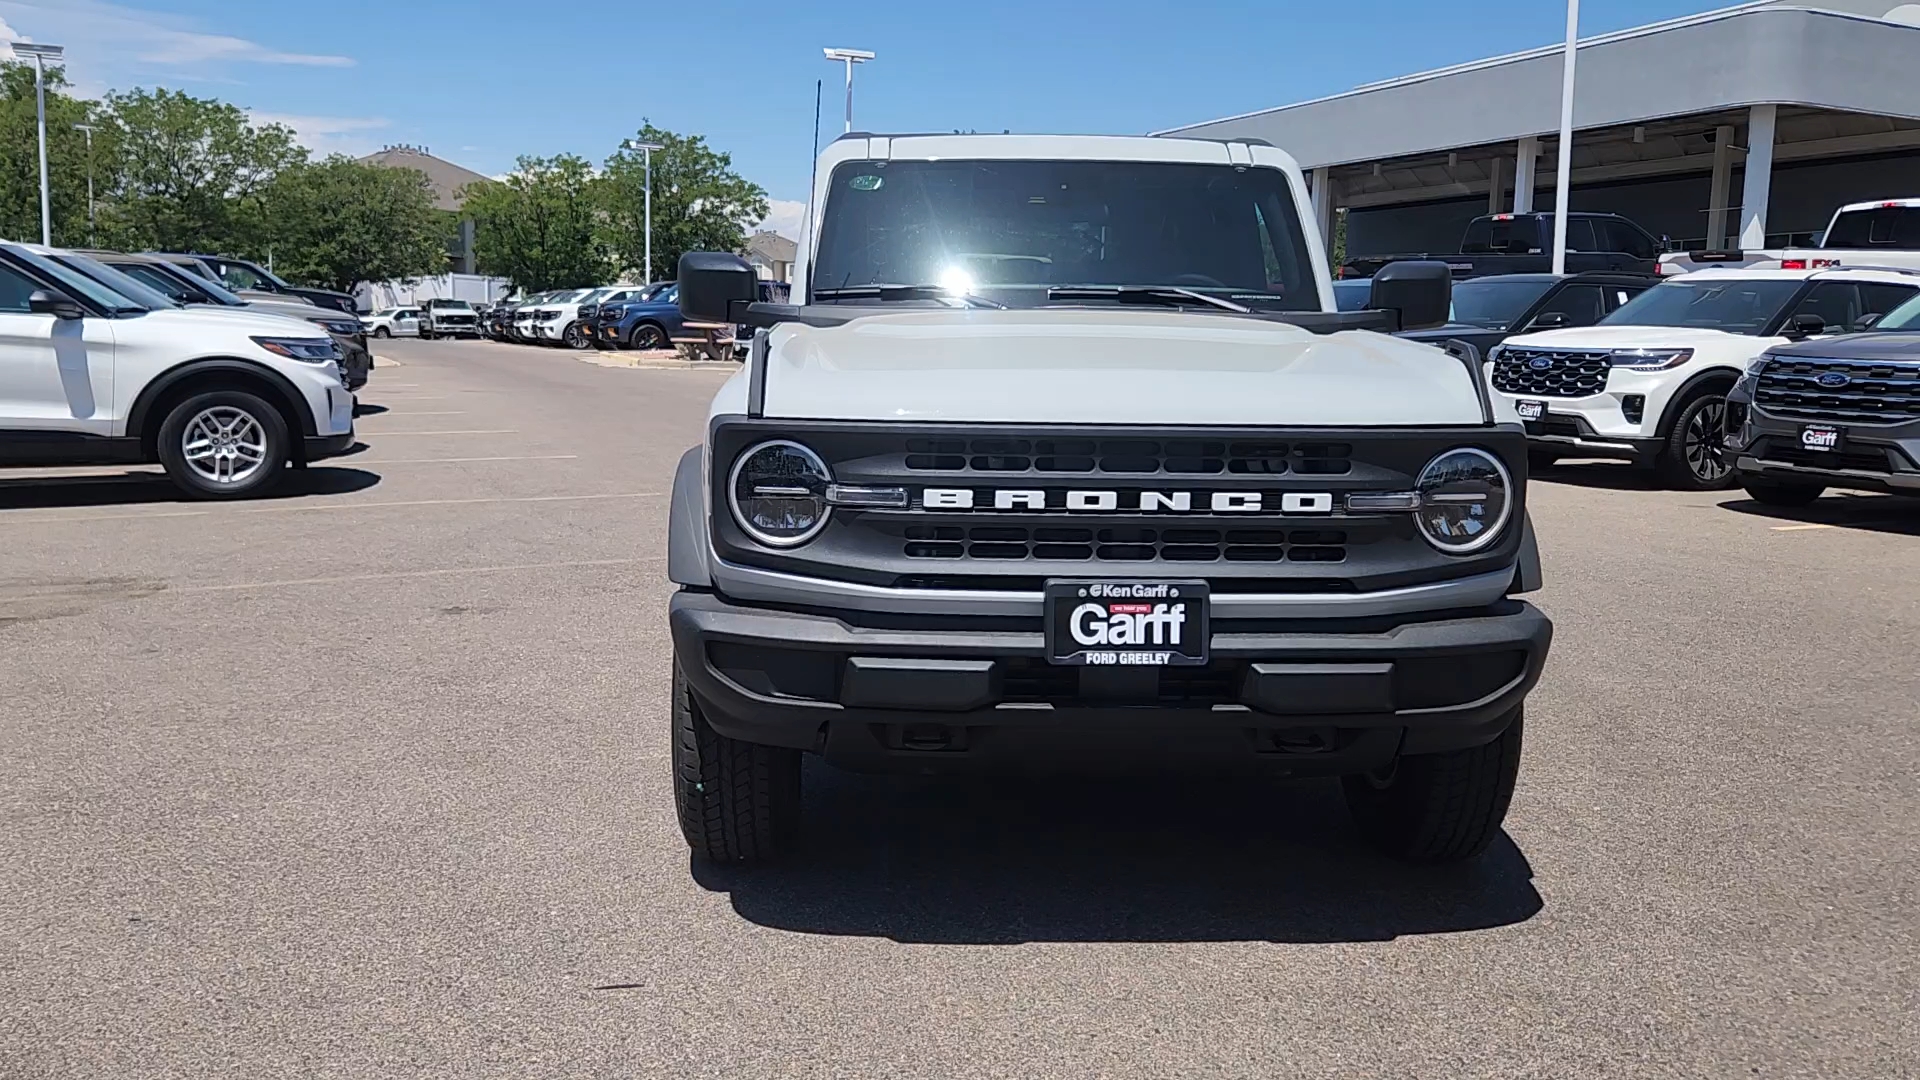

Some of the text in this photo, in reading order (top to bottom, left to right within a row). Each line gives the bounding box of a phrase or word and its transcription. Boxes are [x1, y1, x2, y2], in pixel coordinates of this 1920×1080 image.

[1812, 259, 1841, 268] FX4
[1519, 404, 1542, 417] Garff
[1802, 430, 1838, 446] Garff
[923, 489, 1332, 512] BRONCO
[1102, 585, 1168, 597] Ken Garff
[1070, 603, 1185, 645] Garff
[1086, 653, 1170, 665] FORD GREELEY
